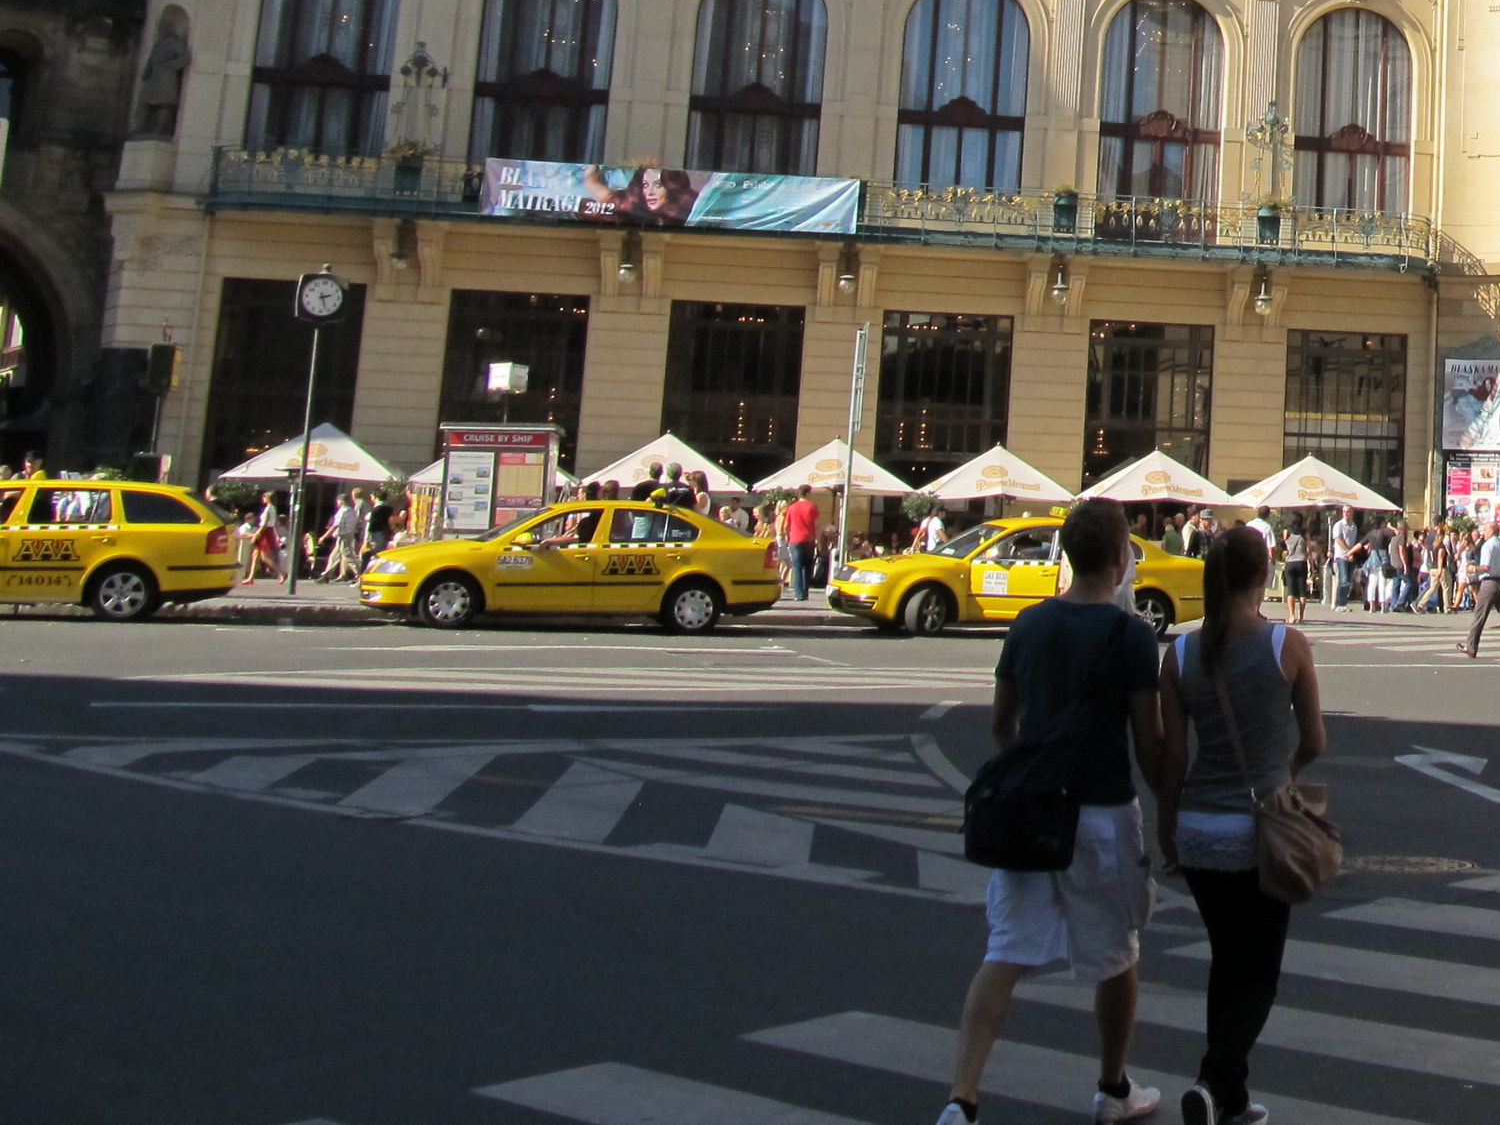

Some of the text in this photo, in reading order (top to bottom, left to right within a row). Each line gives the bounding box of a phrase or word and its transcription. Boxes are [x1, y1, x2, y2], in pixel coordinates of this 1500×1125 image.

[498, 189, 616, 215] MATRAGI 2012
[463, 434, 495, 442] CRUISE
[512, 435, 533, 443] SHIP
[13, 539, 80, 562] AAA
[602, 554, 660, 576] AAA
[19, 575, 62, 586] 14014
